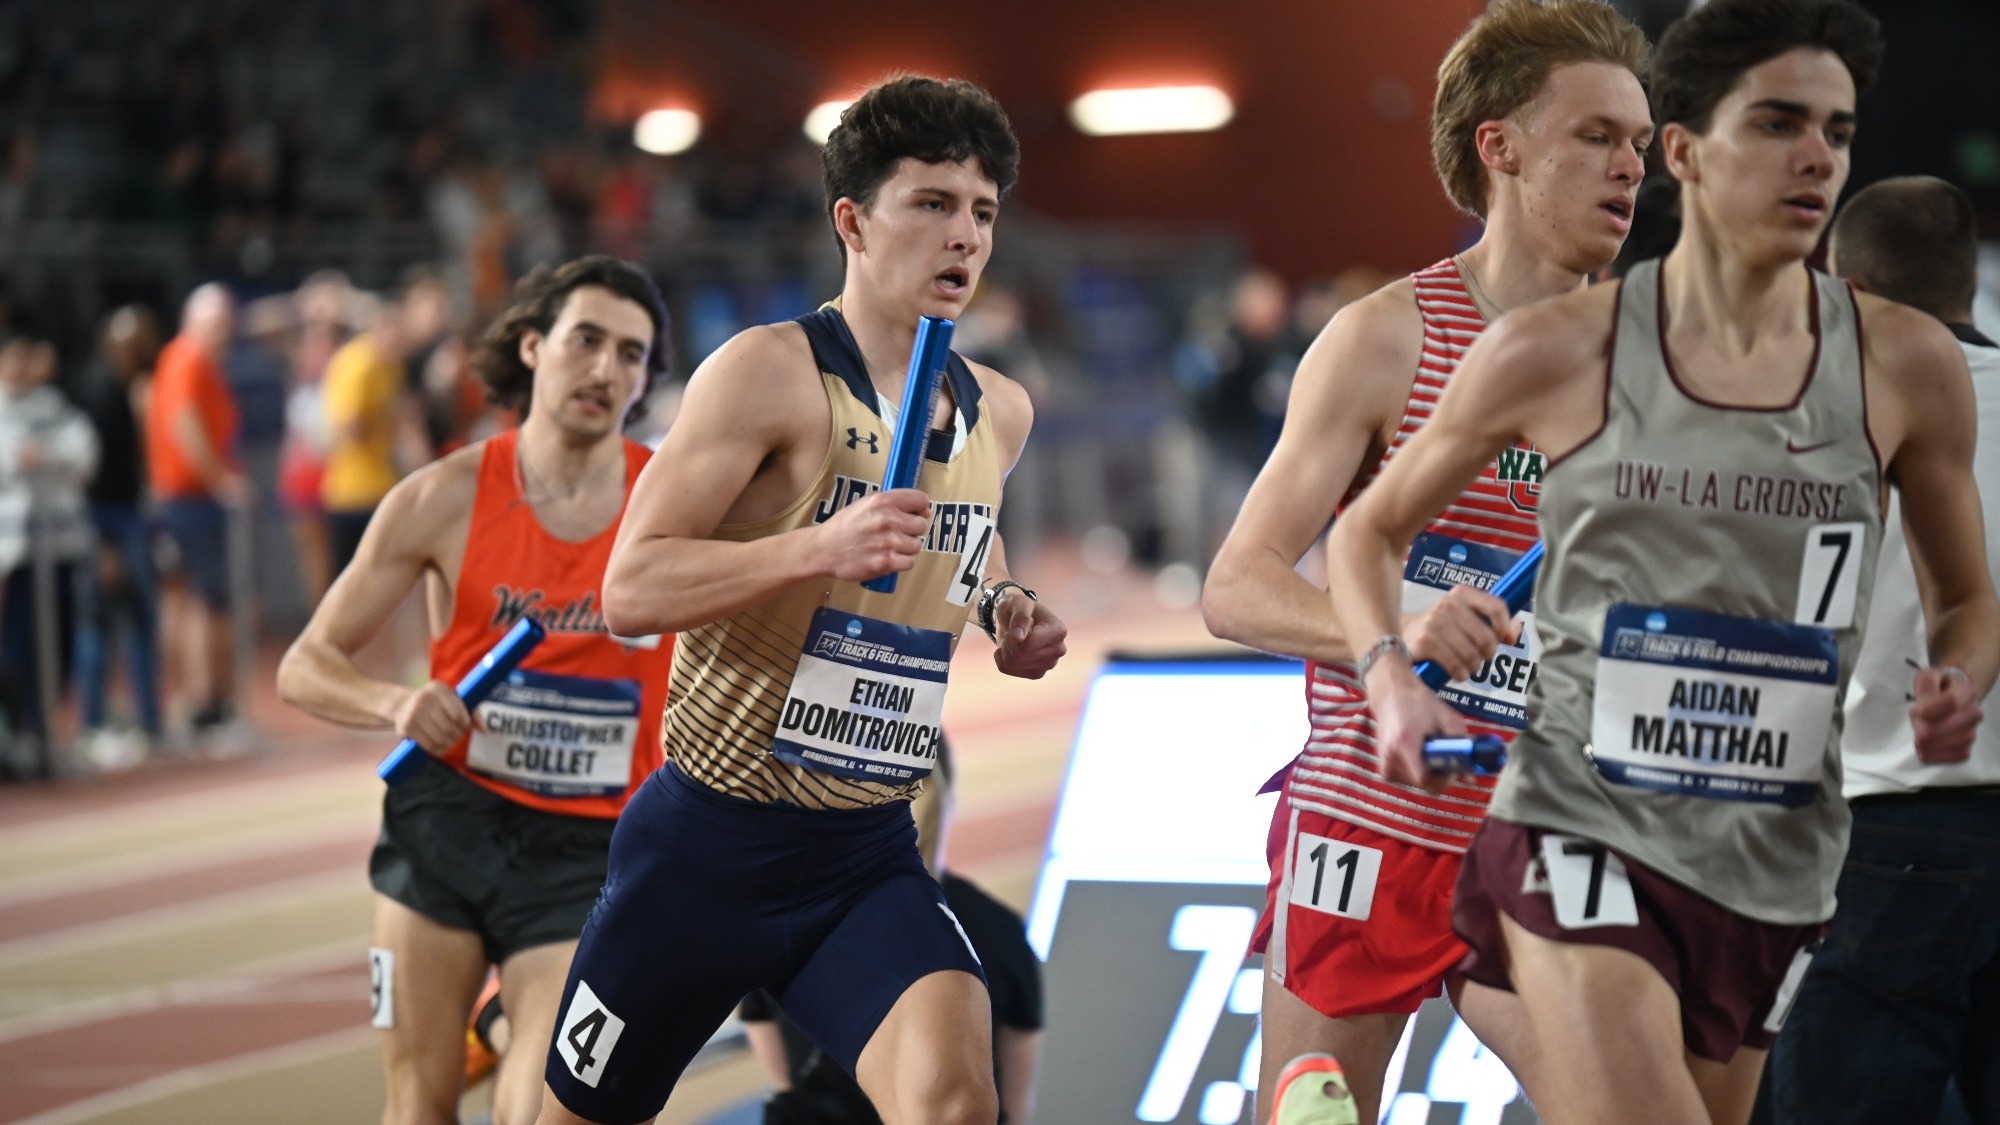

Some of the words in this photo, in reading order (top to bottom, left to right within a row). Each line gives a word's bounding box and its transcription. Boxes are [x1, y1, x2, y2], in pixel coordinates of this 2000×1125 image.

[1733, 474, 1848, 520] CROSSE
[959, 525, 993, 603] 4
[1442, 566, 1478, 587] TRACK
[1813, 531, 1852, 623] 7
[839, 641, 870, 658] TRACK
[867, 648, 877, 660] &
[875, 650, 899, 664] FIELD
[1726, 648, 1830, 675] CHAMPIONSHIPS
[850, 677, 915, 714] ETHAN
[1483, 701, 1509, 715] MARCH
[1668, 678, 1760, 718] AIDAN
[487, 710, 625, 744] CHRISTOPHER
[781, 697, 940, 760] DOMITROVICH
[1631, 714, 1789, 769] MATTHAI
[507, 742, 597, 775] COLLET
[800, 749, 848, 768] BIRMINGHAM,
[865, 764, 885, 774] MARCH
[1309, 842, 1361, 914] 11
[1562, 841, 1608, 919] 7
[567, 1007, 608, 1076] 4
